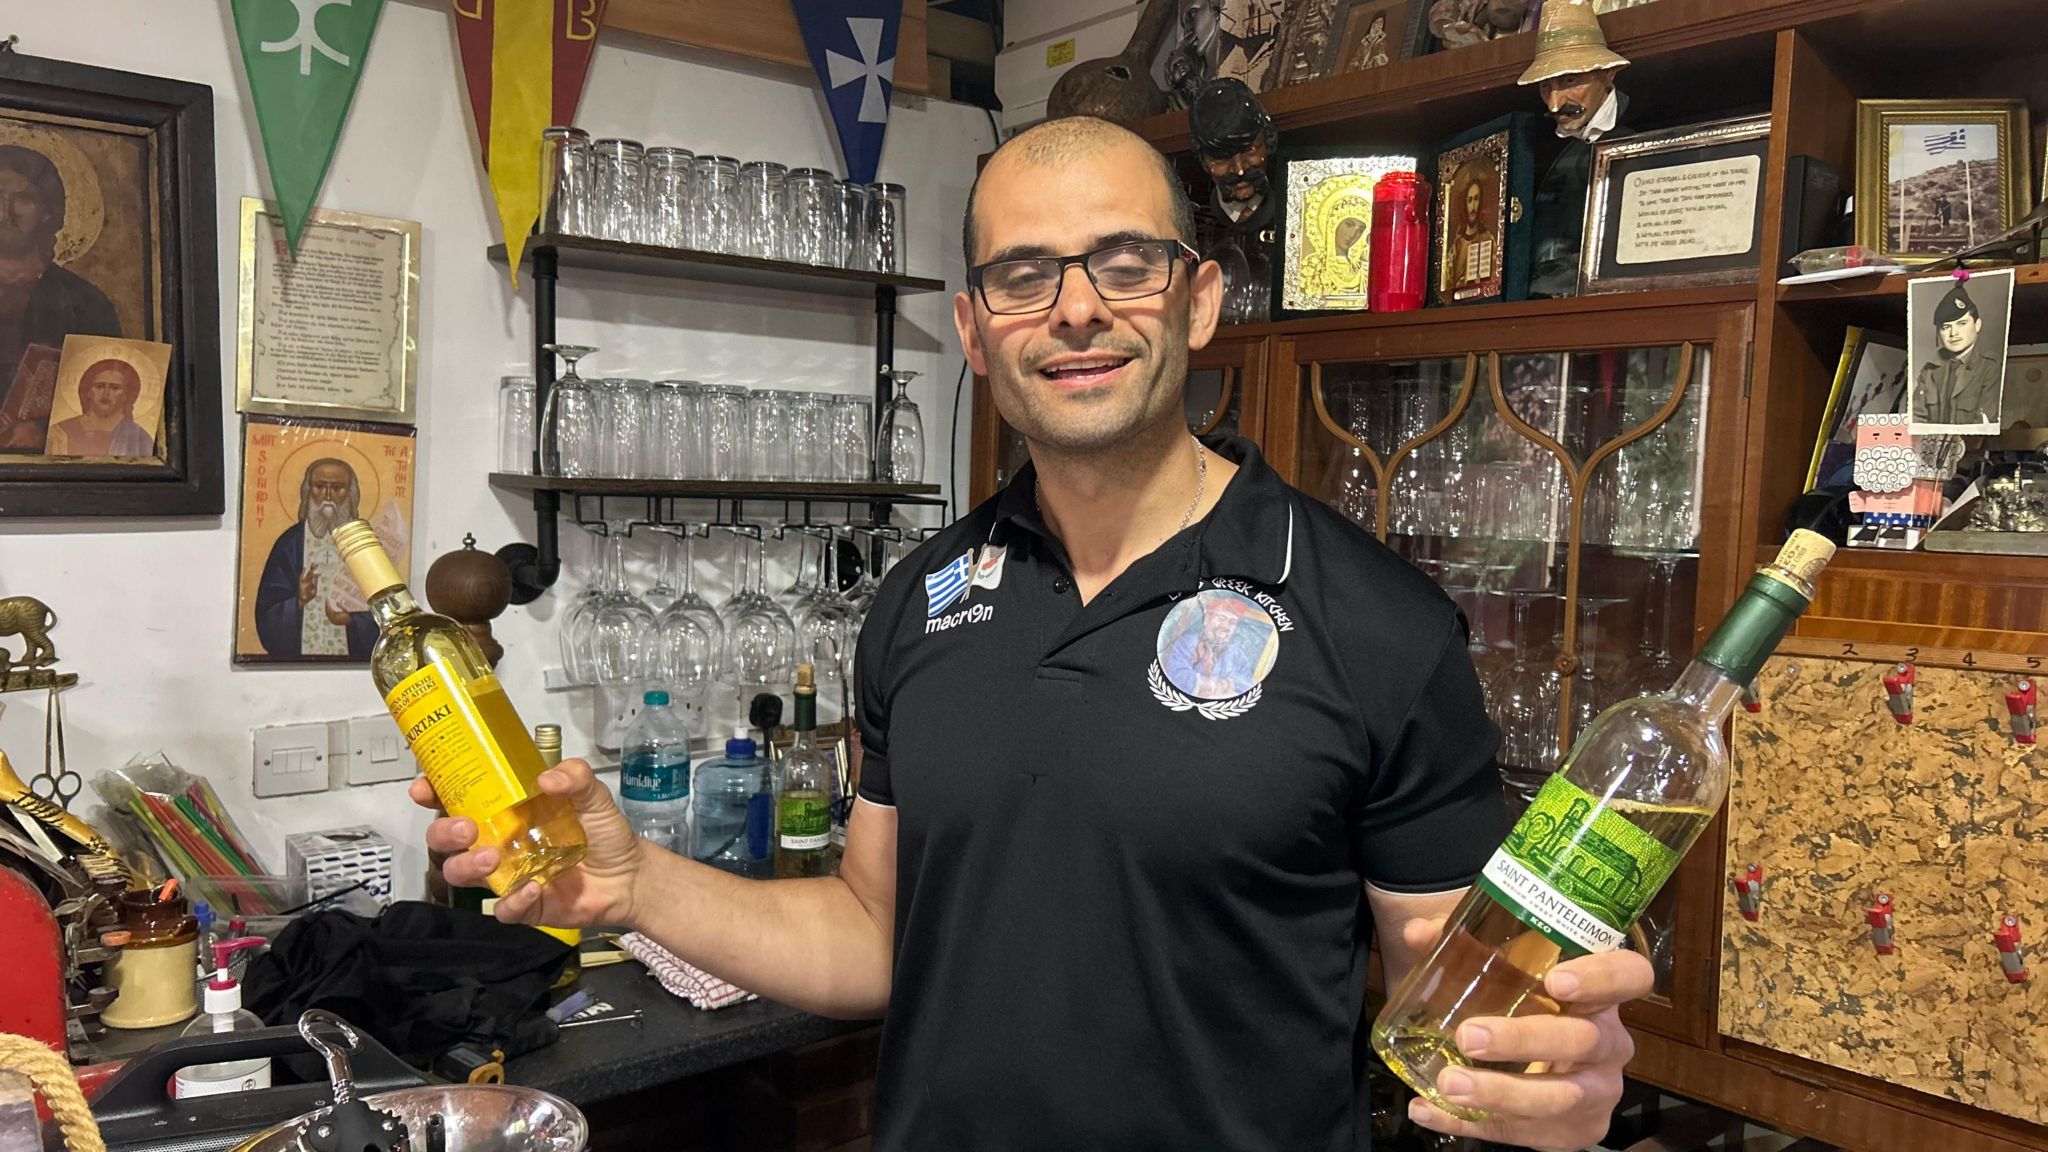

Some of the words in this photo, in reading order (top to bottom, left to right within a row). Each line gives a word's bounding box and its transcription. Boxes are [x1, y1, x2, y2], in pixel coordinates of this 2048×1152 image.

[1211, 577, 1253, 596] GREEK
[1254, 591, 1295, 632] KITCHEN
[1842, 643, 1859, 656] 2
[1905, 648, 1919, 662] 3
[1962, 652, 1977, 666] 4
[2026, 656, 2046, 668] 5
[1497, 860, 1528, 886] SAINT
[1528, 884, 1616, 946] PANTELEIMON
[1530, 917, 1552, 934] KEO
